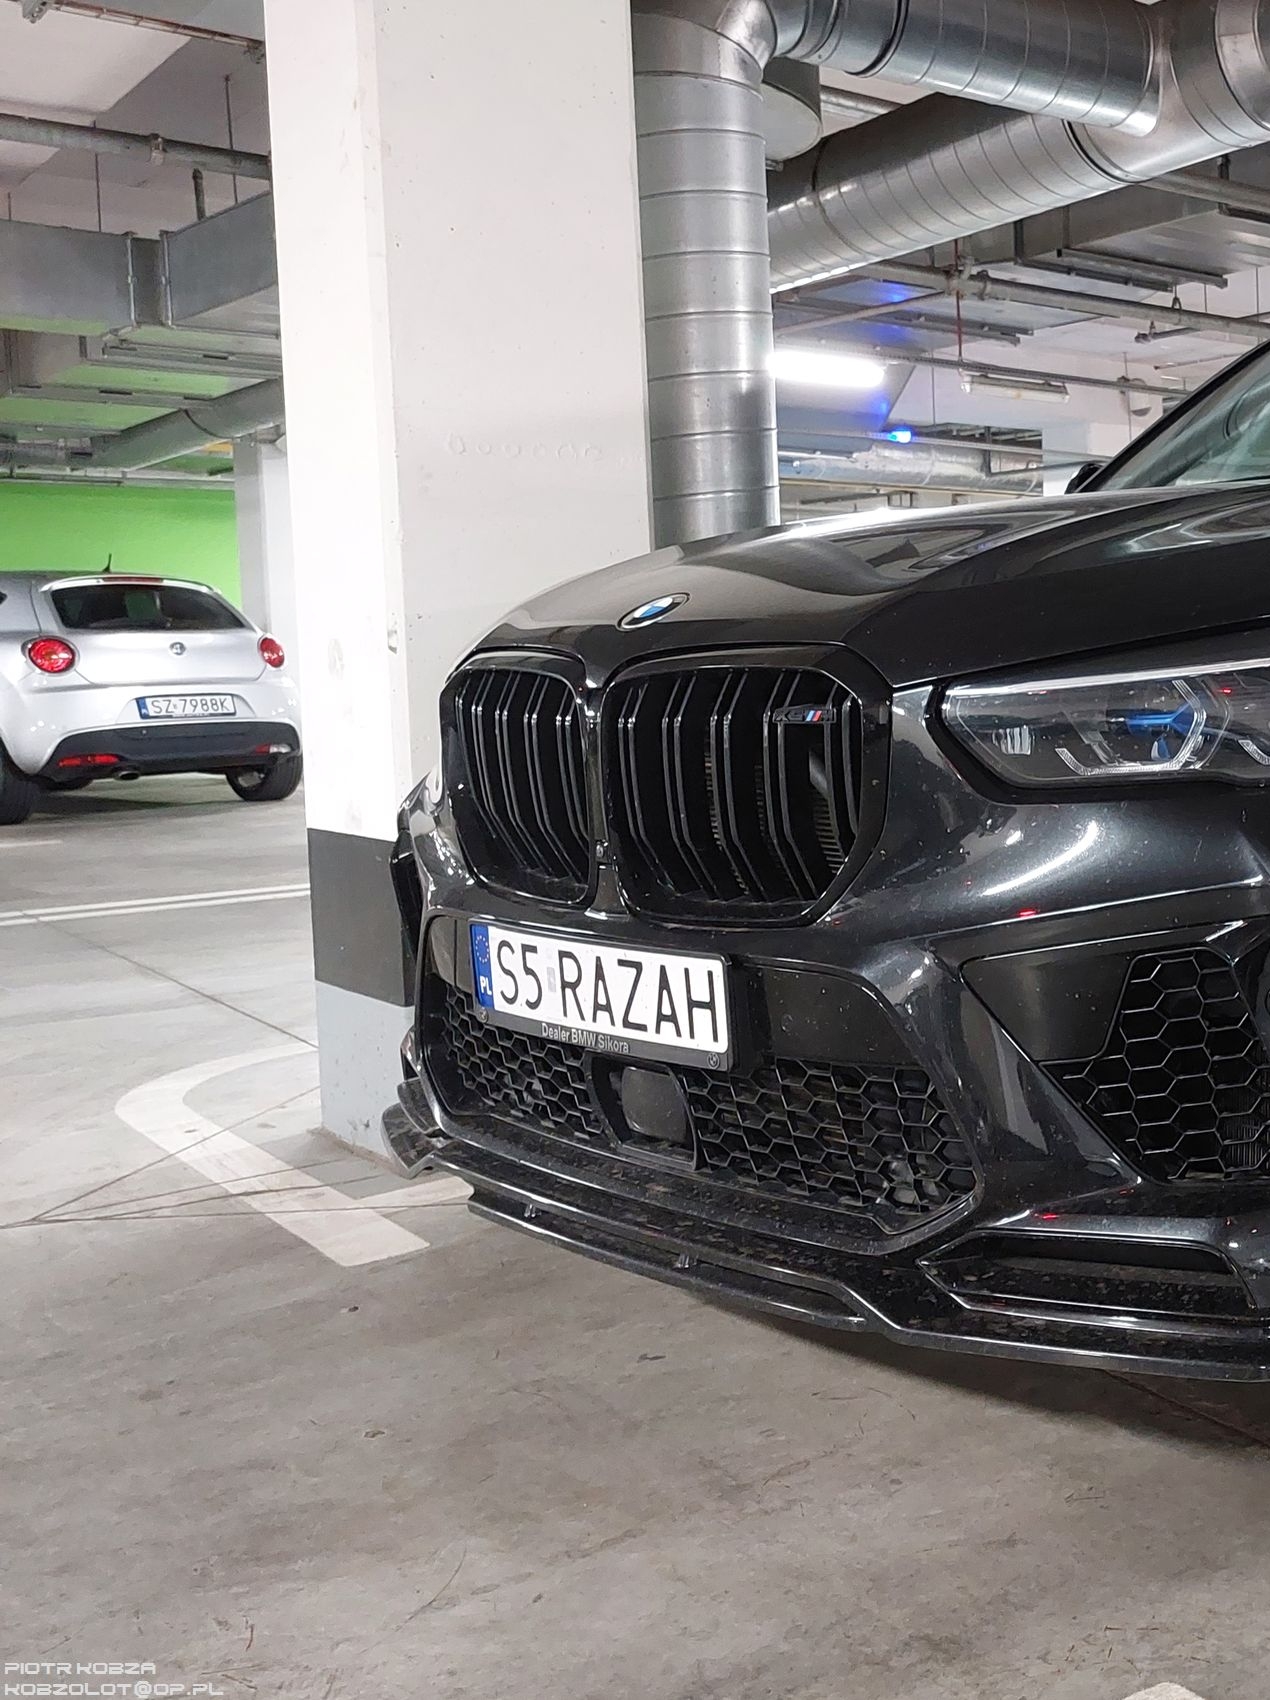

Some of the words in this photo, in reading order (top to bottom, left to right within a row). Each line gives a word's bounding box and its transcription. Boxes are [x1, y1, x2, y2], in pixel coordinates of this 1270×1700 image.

[151, 699, 174, 714] SZ
[179, 698, 230, 713] 7988K
[480, 975, 492, 995] PL
[497, 940, 542, 1010] S5
[558, 950, 719, 1043] RAZAH
[541, 1023, 570, 1041] Dealer
[571, 1029, 596, 1047] BMW
[598, 1035, 629, 1053] Sikora
